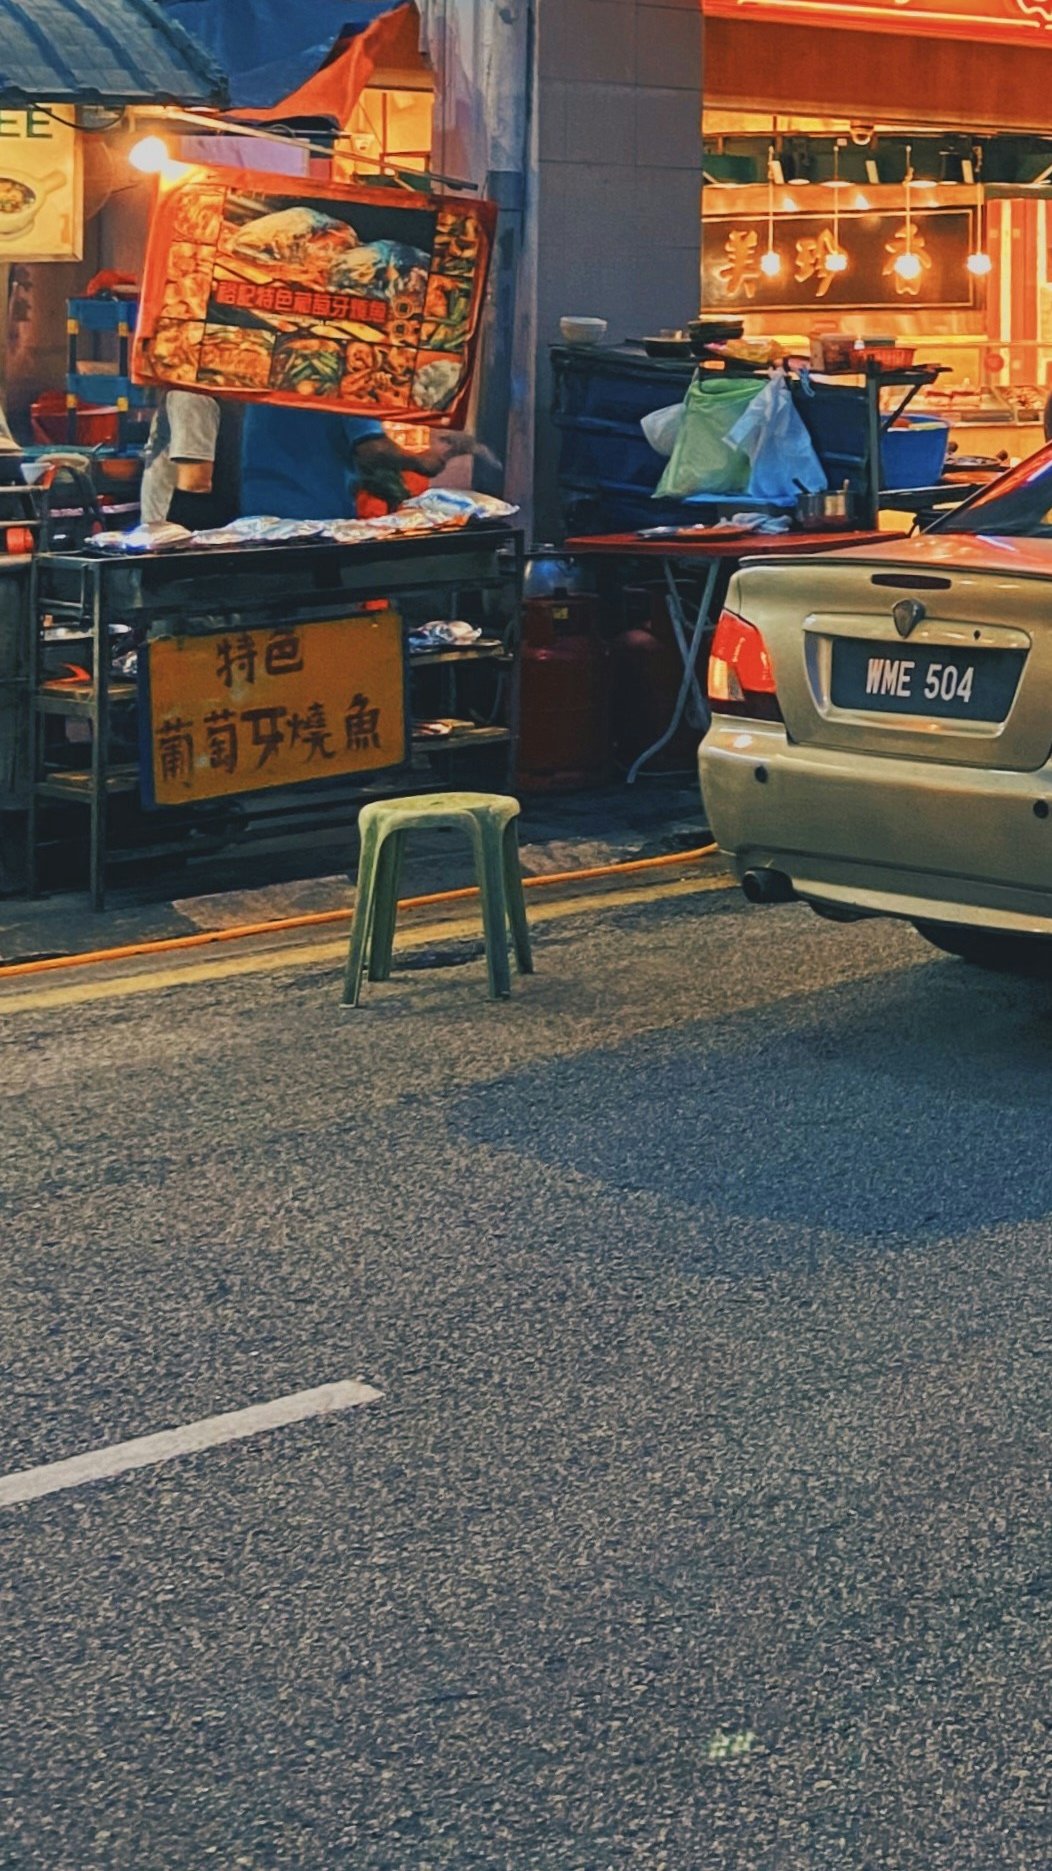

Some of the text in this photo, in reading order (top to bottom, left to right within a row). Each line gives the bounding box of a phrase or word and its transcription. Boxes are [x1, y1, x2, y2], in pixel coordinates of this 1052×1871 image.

[215, 629, 304, 688] 特色
[866, 658, 975, 703] WME 504
[155, 692, 381, 789] 葡萄牙燒魚
